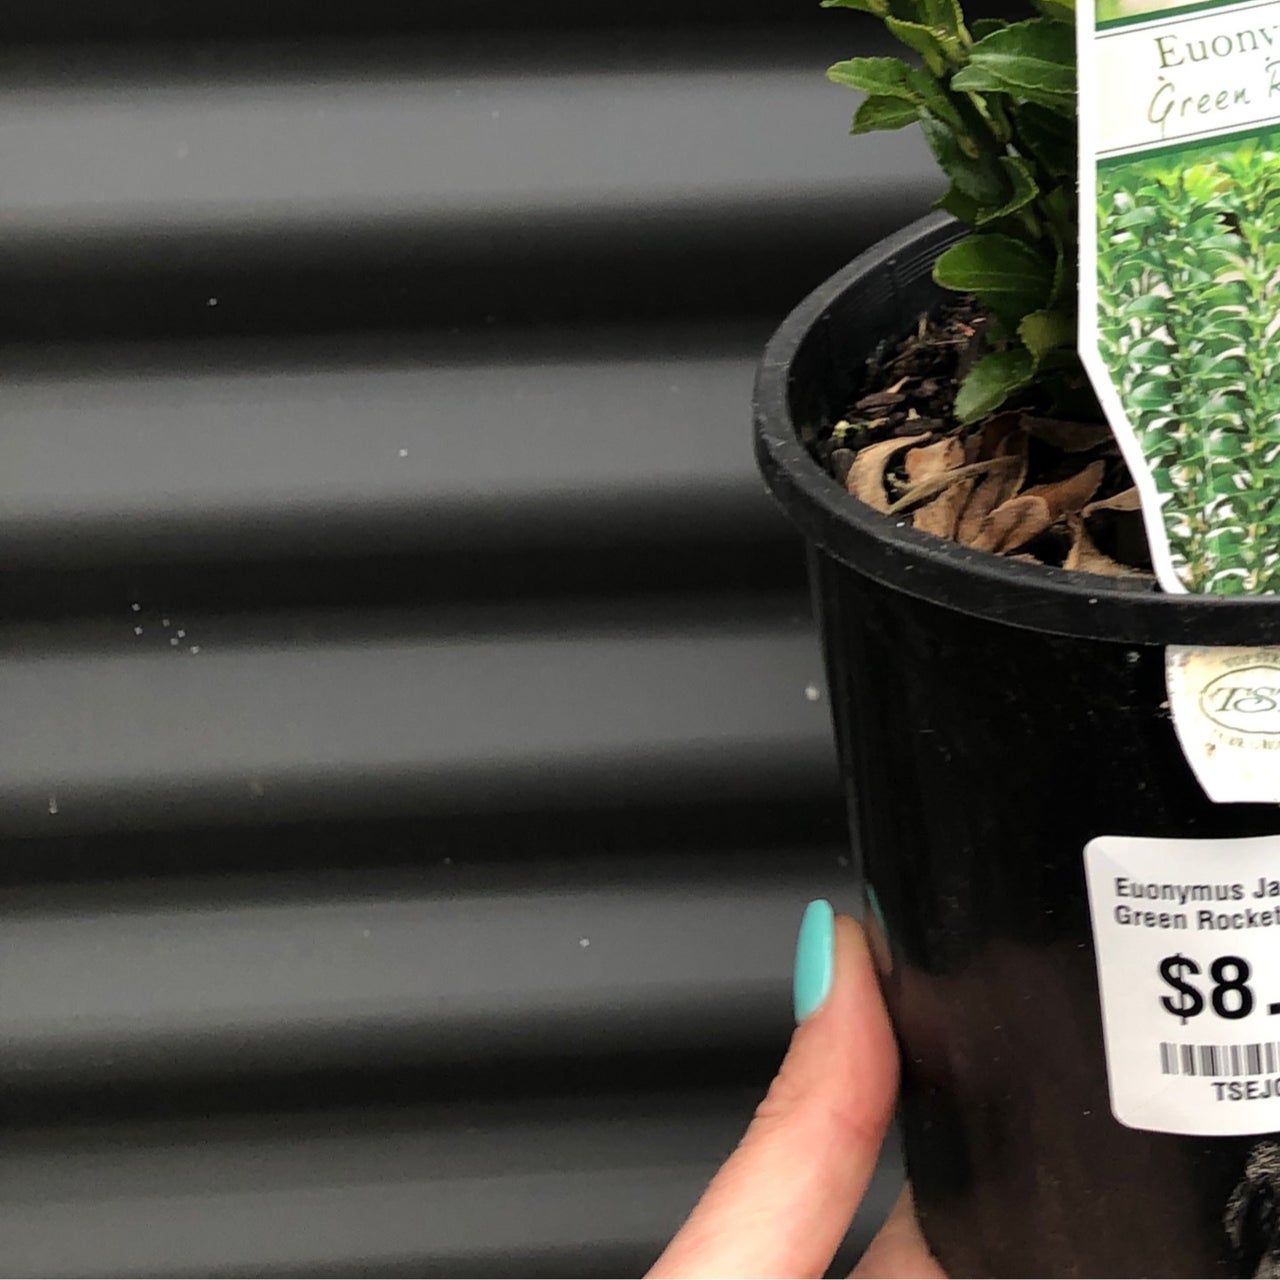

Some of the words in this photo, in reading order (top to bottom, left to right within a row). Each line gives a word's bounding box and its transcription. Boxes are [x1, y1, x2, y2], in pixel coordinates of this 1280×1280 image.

[1147, 80, 1251, 139] Green
[1114, 877, 1244, 905] Euonymus
[1113, 905, 1189, 930] Green
